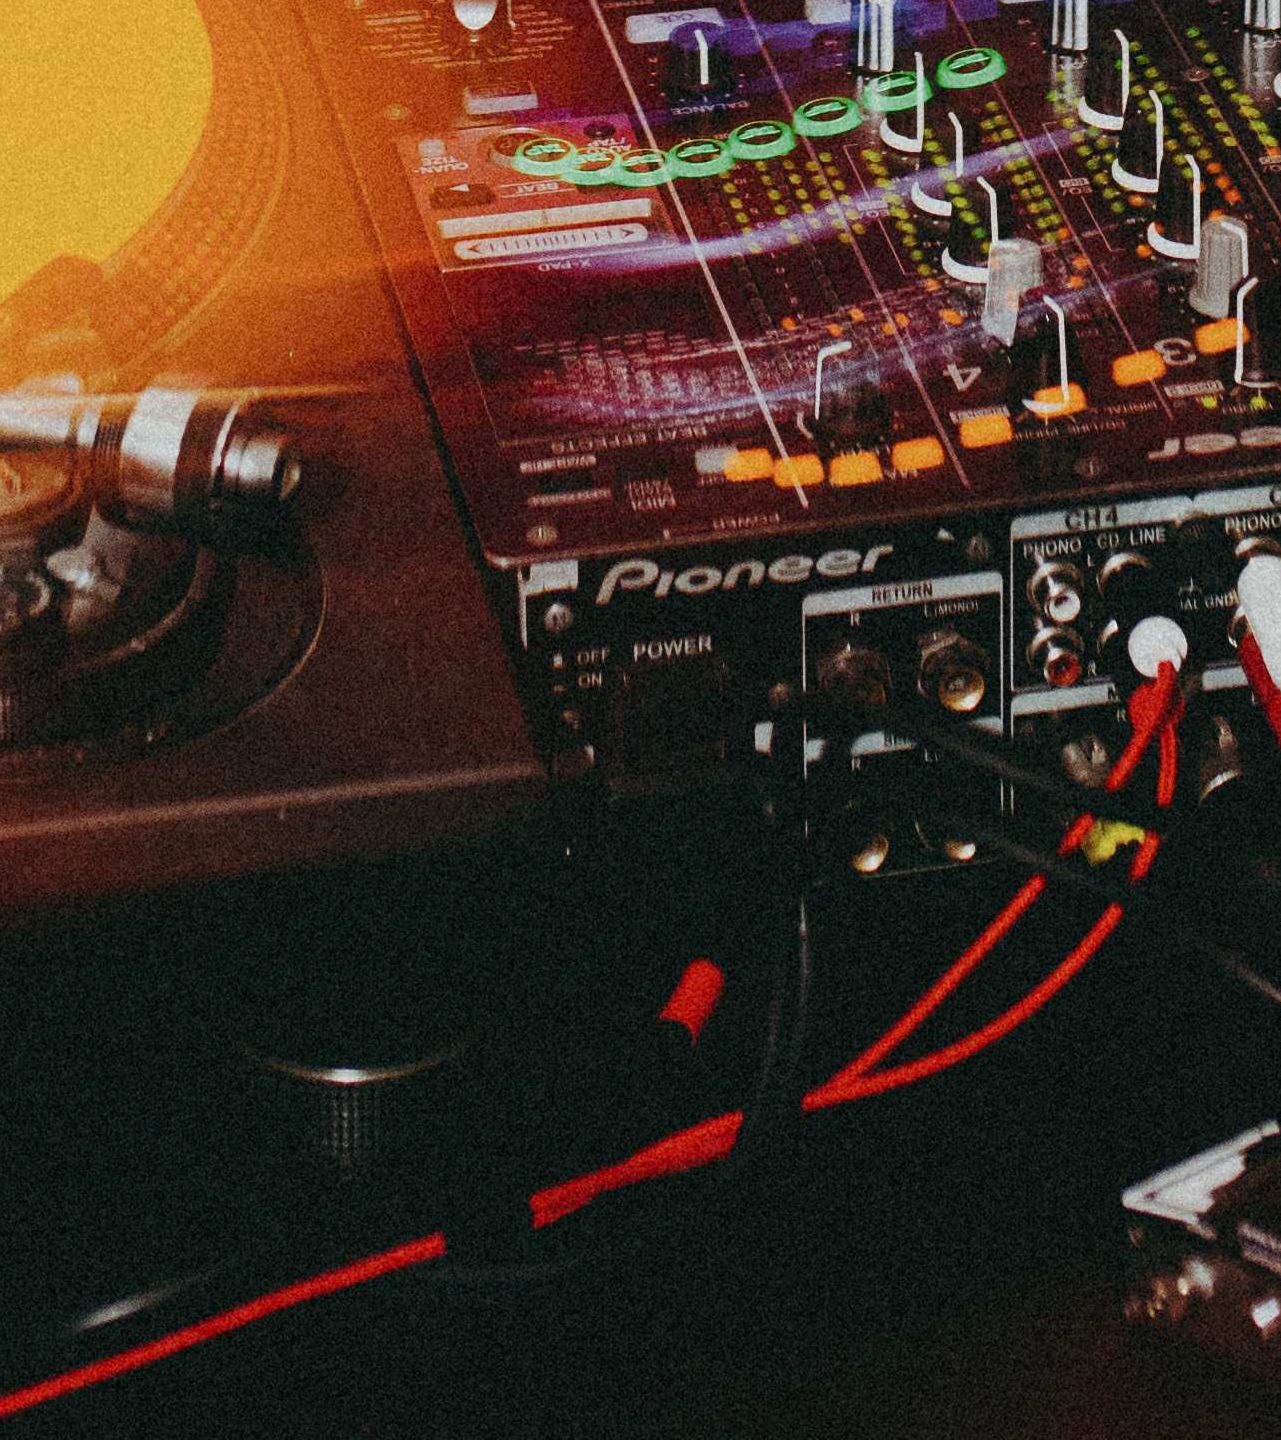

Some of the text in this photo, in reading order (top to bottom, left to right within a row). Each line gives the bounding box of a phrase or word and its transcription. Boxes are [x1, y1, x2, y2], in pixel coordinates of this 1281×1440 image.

[537, 258, 592, 272] X-PAD
[1153, 337, 1198, 367] 3
[942, 363, 982, 392] 4
[1021, 527, 1167, 560] PHONO CD LINE
[595, 543, 894, 605] Pioneer
[871, 581, 933, 603] RETURN
[576, 646, 611, 666] OFF
[632, 633, 713, 662] POWER
[577, 671, 604, 689] ON
